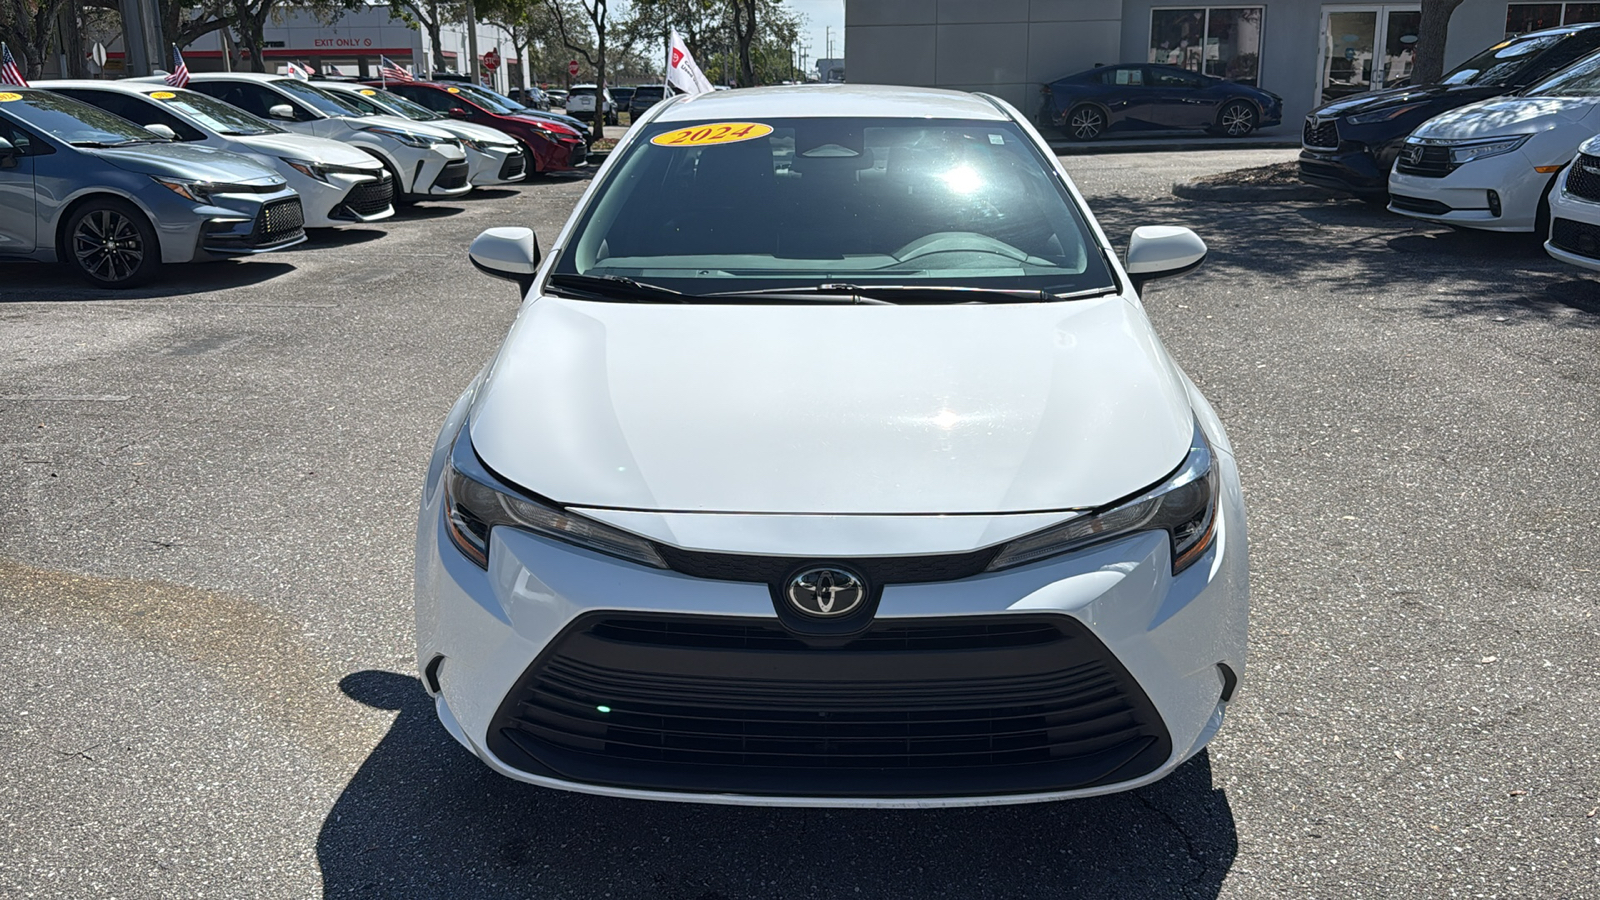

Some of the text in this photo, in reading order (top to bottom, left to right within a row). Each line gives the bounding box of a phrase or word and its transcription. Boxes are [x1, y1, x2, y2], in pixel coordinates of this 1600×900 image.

[314, 38, 361, 47] EXIT ONLY
[667, 124, 756, 145] 2024
